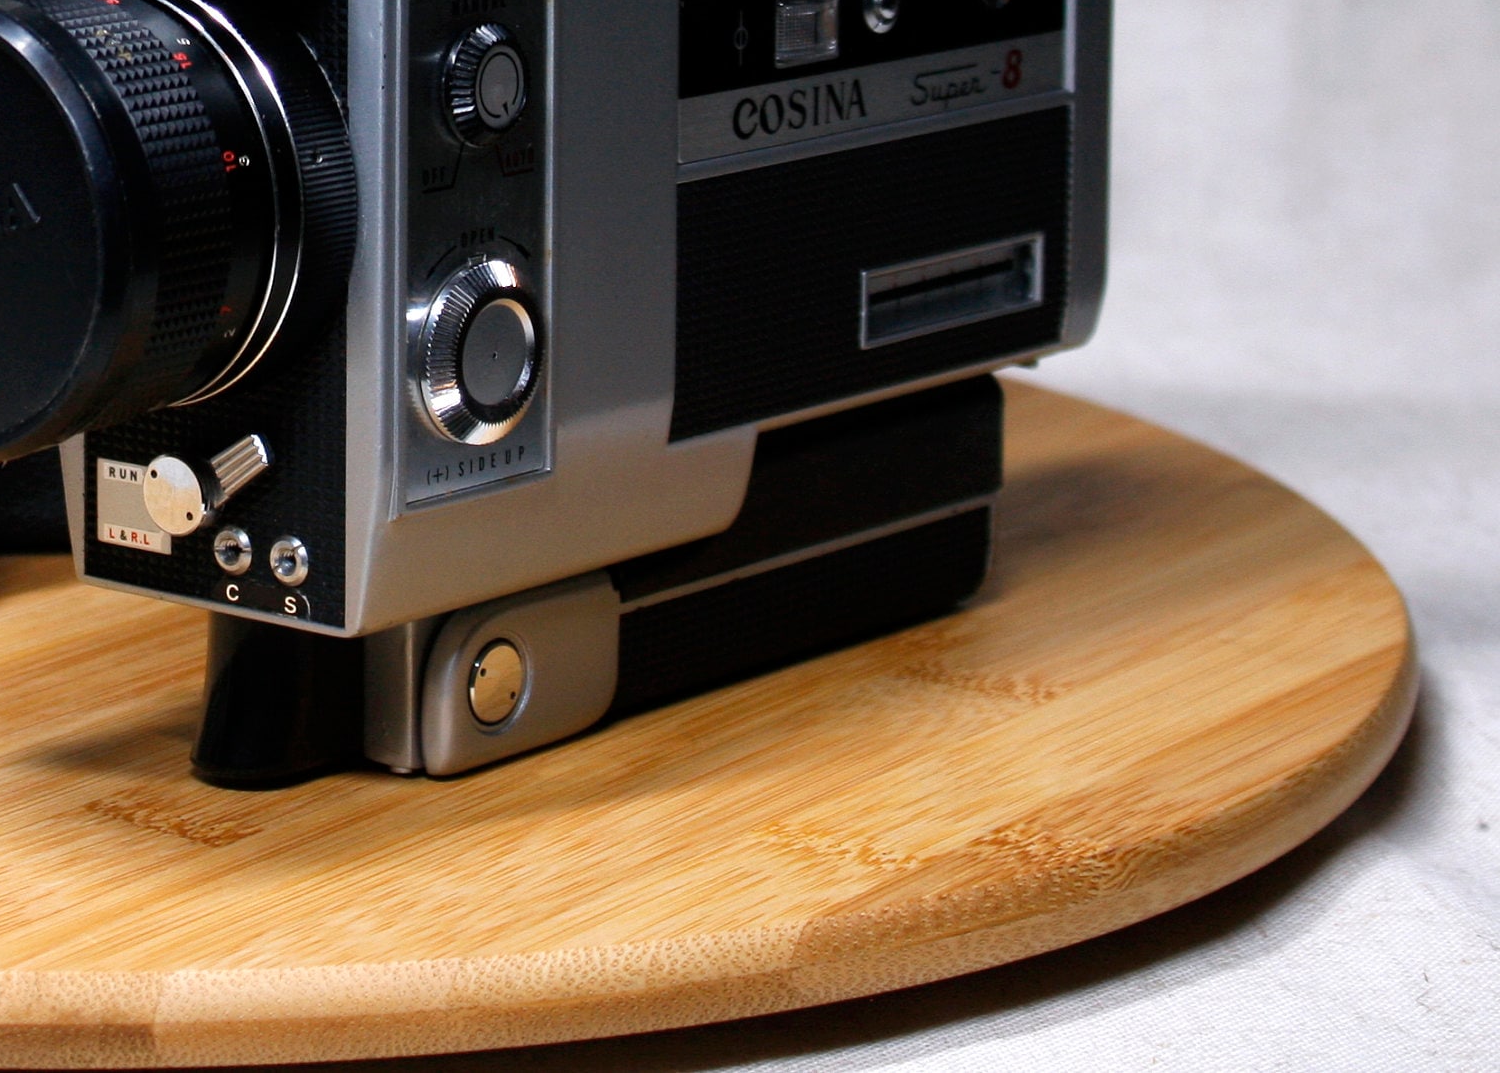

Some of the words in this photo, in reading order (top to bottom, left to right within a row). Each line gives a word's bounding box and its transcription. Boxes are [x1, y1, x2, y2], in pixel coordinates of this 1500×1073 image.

[732, 78, 868, 141] COSINA
[460, 226, 495, 249] OPEN
[108, 466, 139, 482] RUN
[225, 583, 240, 602] C
[283, 595, 298, 615] S
